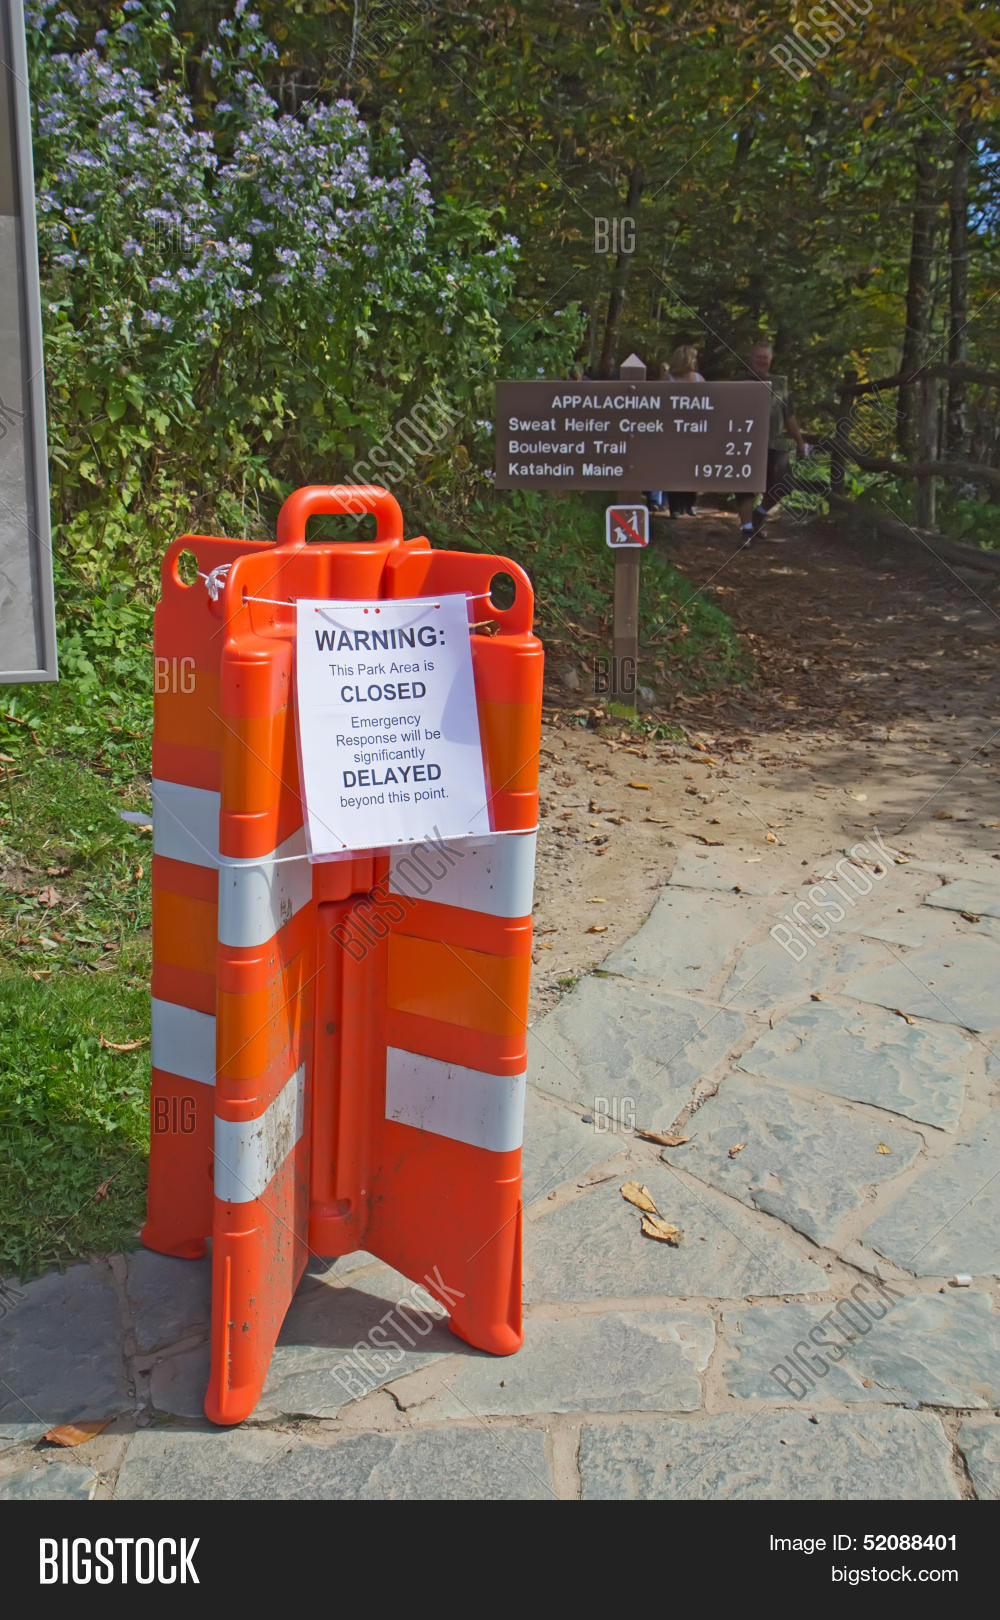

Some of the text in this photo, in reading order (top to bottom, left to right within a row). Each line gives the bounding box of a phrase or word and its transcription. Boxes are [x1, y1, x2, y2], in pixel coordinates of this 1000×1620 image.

[551, 395, 714, 410] APPALACHIAN TRAIL
[508, 417, 754, 433] Sweat Heifer Creek Trail 1.7
[508, 441, 753, 456] Boulevard Trail 2.7
[508, 463, 752, 479] Katahdin Maine 1972.0
[315, 626, 446, 651] WARNING:
[329, 660, 435, 676] This Park Area is
[341, 681, 426, 702] CLOSED
[351, 714, 421, 729] Emergency
[336, 729, 441, 748] Response will be
[354, 747, 426, 764] significantly
[343, 764, 442, 788] DELAYED
[340, 788, 449, 809] beyond this point.
